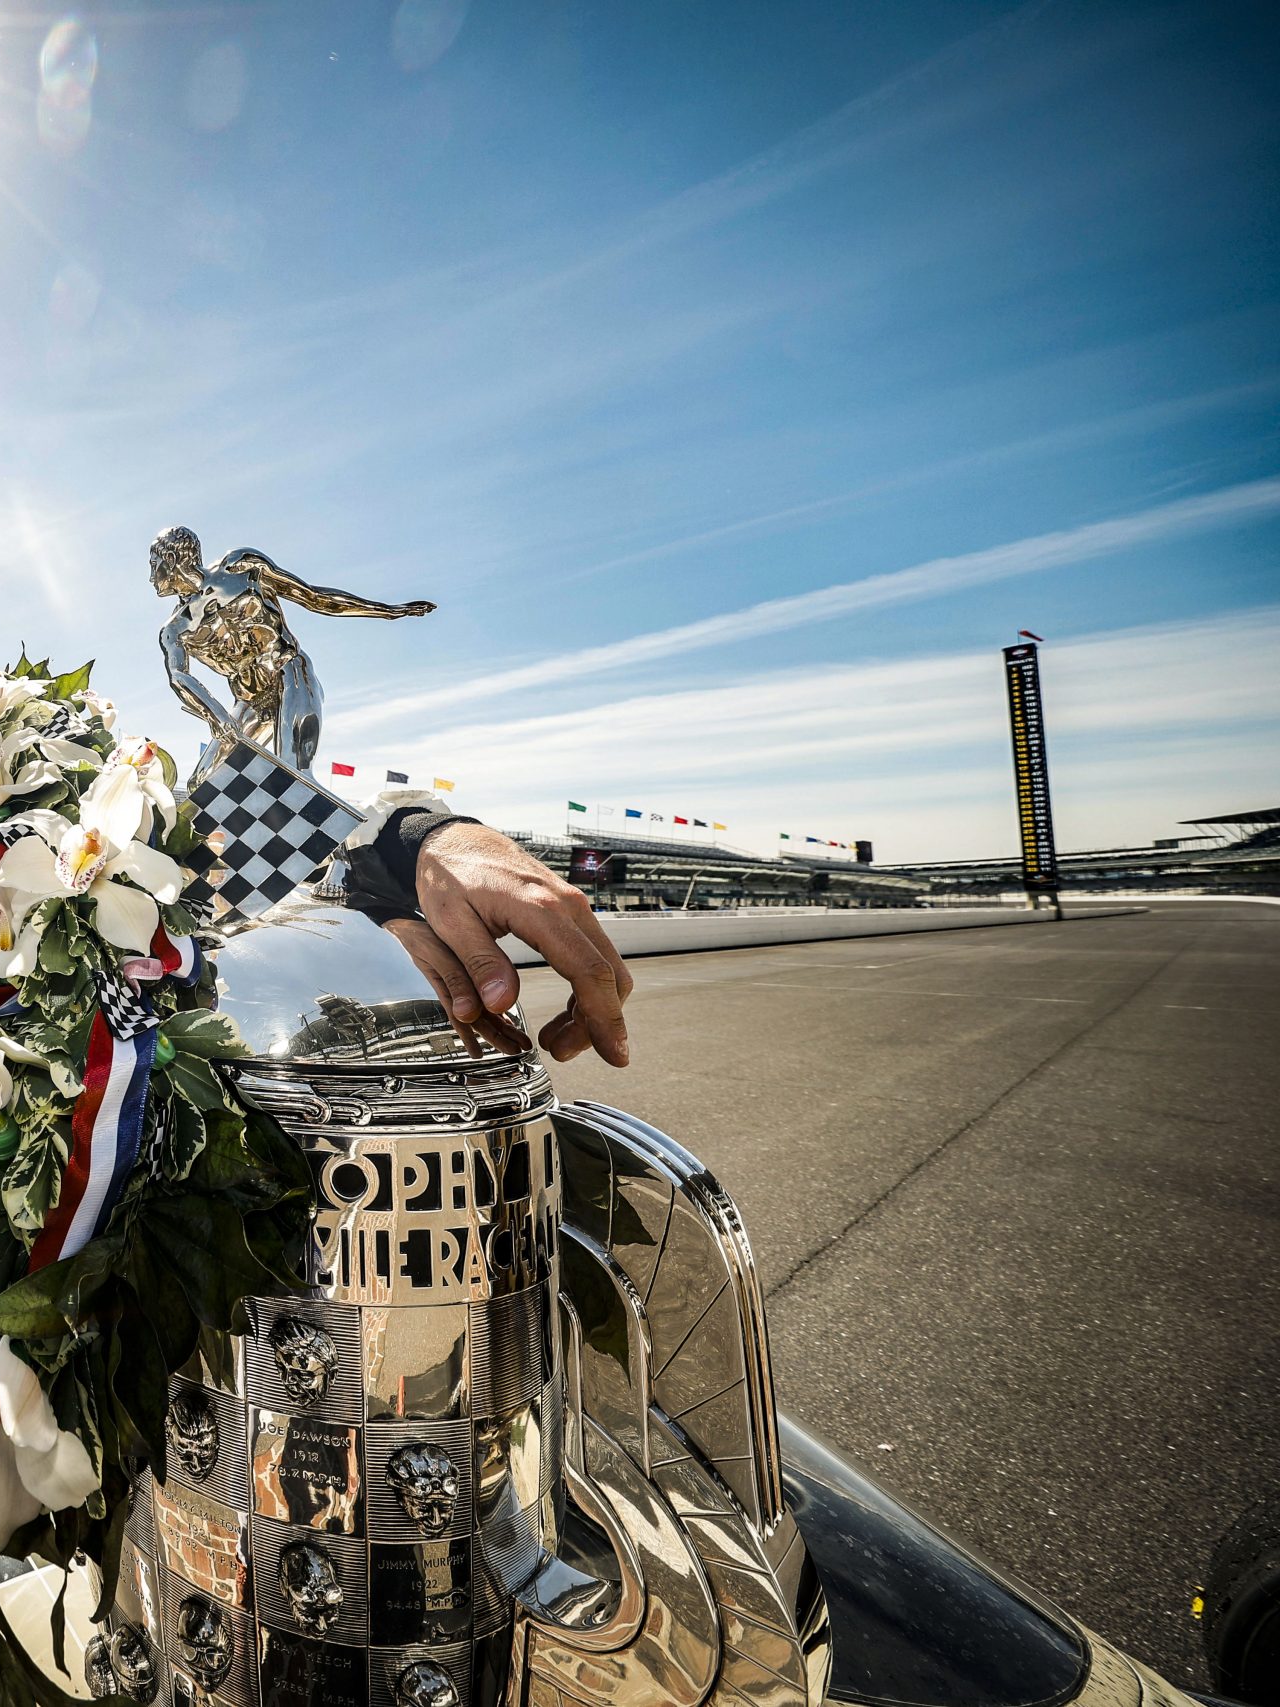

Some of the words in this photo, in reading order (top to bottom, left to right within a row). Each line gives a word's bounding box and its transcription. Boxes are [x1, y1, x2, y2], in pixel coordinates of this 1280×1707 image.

[320, 1150, 522, 1212] OPHY
[258, 1421, 285, 1436] JOE
[292, 1430, 351, 1447] DAWSON
[294, 1449, 319, 1463] 1912
[199, 1511, 241, 1535] MILTON
[378, 1559, 416, 1570] JIMMY
[423, 1553, 465, 1569] MURPHY
[411, 1580, 438, 1592] 1922
